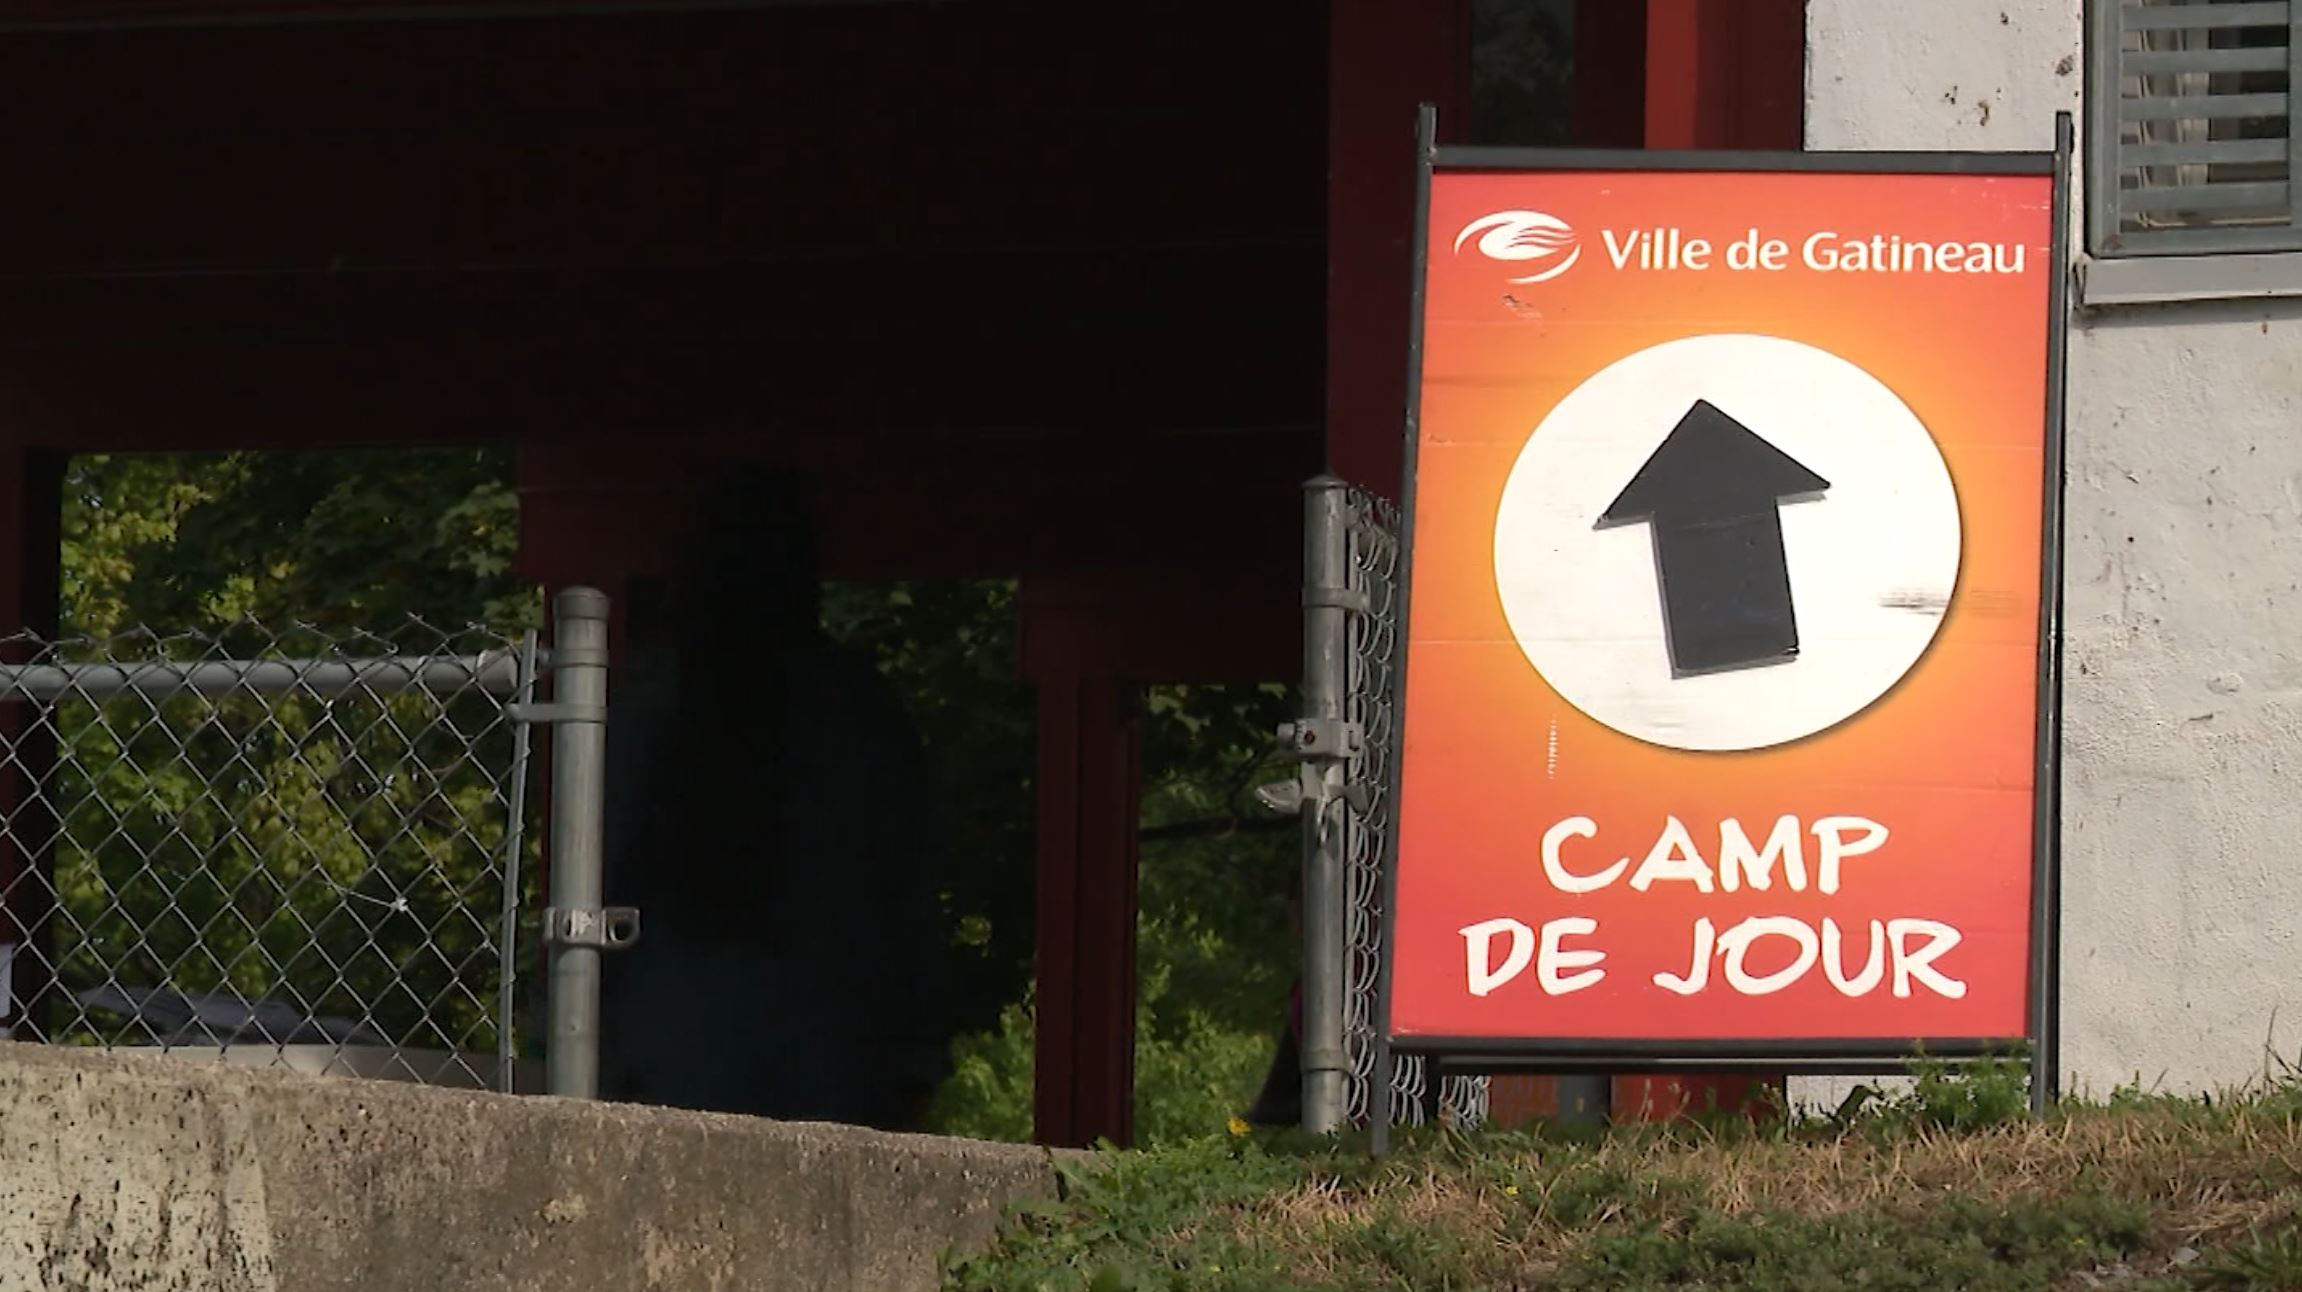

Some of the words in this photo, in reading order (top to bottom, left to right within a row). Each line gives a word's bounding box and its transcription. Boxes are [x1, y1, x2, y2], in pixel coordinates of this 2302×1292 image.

[1601, 227, 1712, 271] Ville
[1726, 227, 1789, 271] de
[1802, 230, 2026, 275] Gatineau
[1541, 814, 1889, 895] CAMP
[1457, 916, 1607, 997] DE
[1652, 915, 1968, 999] JOUR
